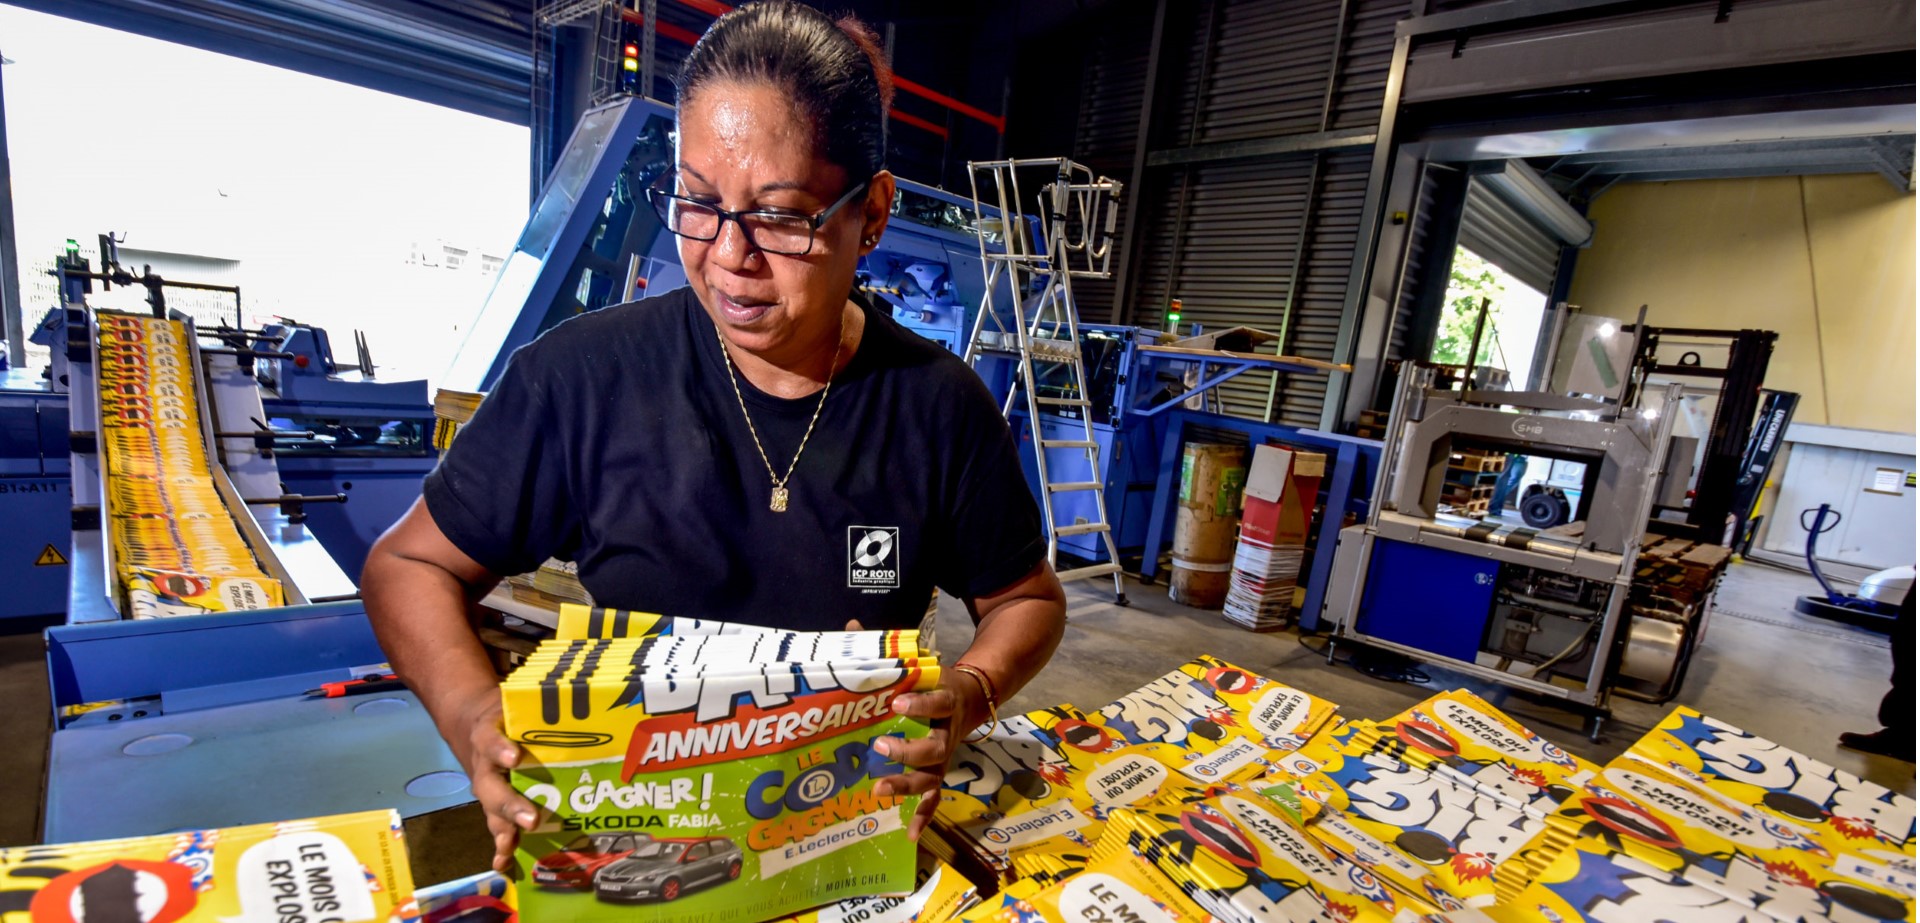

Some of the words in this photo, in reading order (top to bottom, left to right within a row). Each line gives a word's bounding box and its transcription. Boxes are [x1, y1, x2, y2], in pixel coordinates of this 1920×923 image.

[852, 569, 868, 578] ICP
[870, 570, 896, 578] ROTO
[1292, 694, 1303, 704] LE
[1279, 702, 1296, 721] MOIS
[639, 689, 895, 766] ANNIVERSAIRE
[1267, 719, 1283, 732] QUI
[1448, 704, 1468, 716] LE
[1467, 716, 1504, 738] MOIS
[1504, 738, 1531, 753] QUI
[797, 747, 824, 771] LE
[578, 769, 593, 784] À
[1121, 771, 1148, 790] MOIS
[1144, 765, 1159, 777] LE
[1104, 786, 1124, 800] QUI
[1623, 774, 1645, 787] LE
[1653, 787, 1711, 815] MOIS
[1715, 815, 1755, 836] QUI
[563, 814, 664, 832] ŠKODA
[668, 813, 722, 829] FABIA
[1005, 809, 1075, 835] E.Leclerc
[784, 827, 856, 860] E.Leclerc
[1236, 803, 1260, 817] LE
[1259, 818, 1306, 851] MOIS
[1308, 854, 1338, 876] QUI
[298, 842, 327, 863] LE
[303, 866, 342, 914] MOIS
[825, 875, 857, 893] MOINS
[1088, 882, 1119, 905] LE
